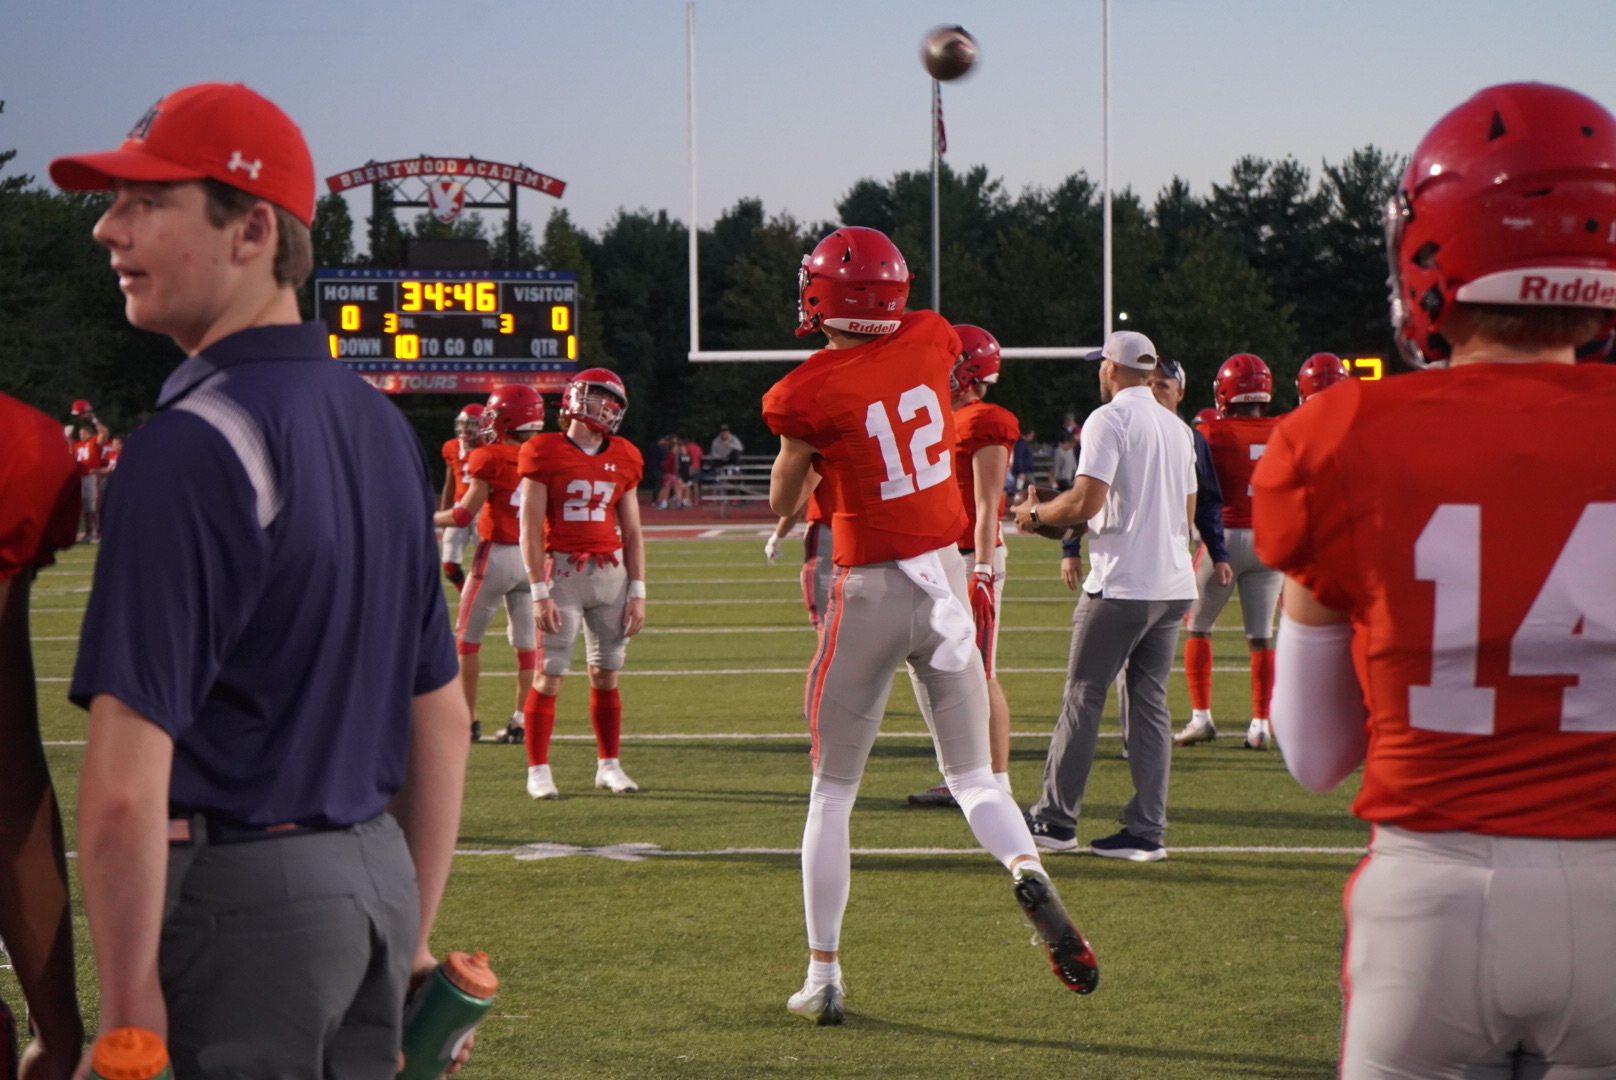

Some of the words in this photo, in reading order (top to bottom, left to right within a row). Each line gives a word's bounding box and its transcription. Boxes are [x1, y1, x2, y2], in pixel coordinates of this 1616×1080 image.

[340, 160, 457, 187] BRENTWOOD
[463, 162, 554, 190] ACADEMY
[504, 271, 557, 279] FIELD
[323, 285, 378, 301] HOME
[401, 281, 496, 312] 34:46
[513, 286, 574, 303] VISITOR
[1520, 275, 1616, 304] Ridde
[340, 304, 361, 331] 0
[382, 313, 399, 333] 3
[499, 313, 515, 334] 3
[551, 306, 570, 332] 0
[848, 320, 897, 335] Riddell
[338, 338, 382, 356] DOWN
[394, 334, 419, 359] 10
[419, 338, 439, 356] TO
[444, 338, 465, 356] GO
[472, 338, 494, 356] ON
[530, 338, 559, 358] QTR
[566, 334, 577, 359] 1
[398, 375, 457, 390] TOURS
[864, 384, 952, 501] 12
[563, 480, 617, 522] 27
[1408, 502, 1616, 736] 14
